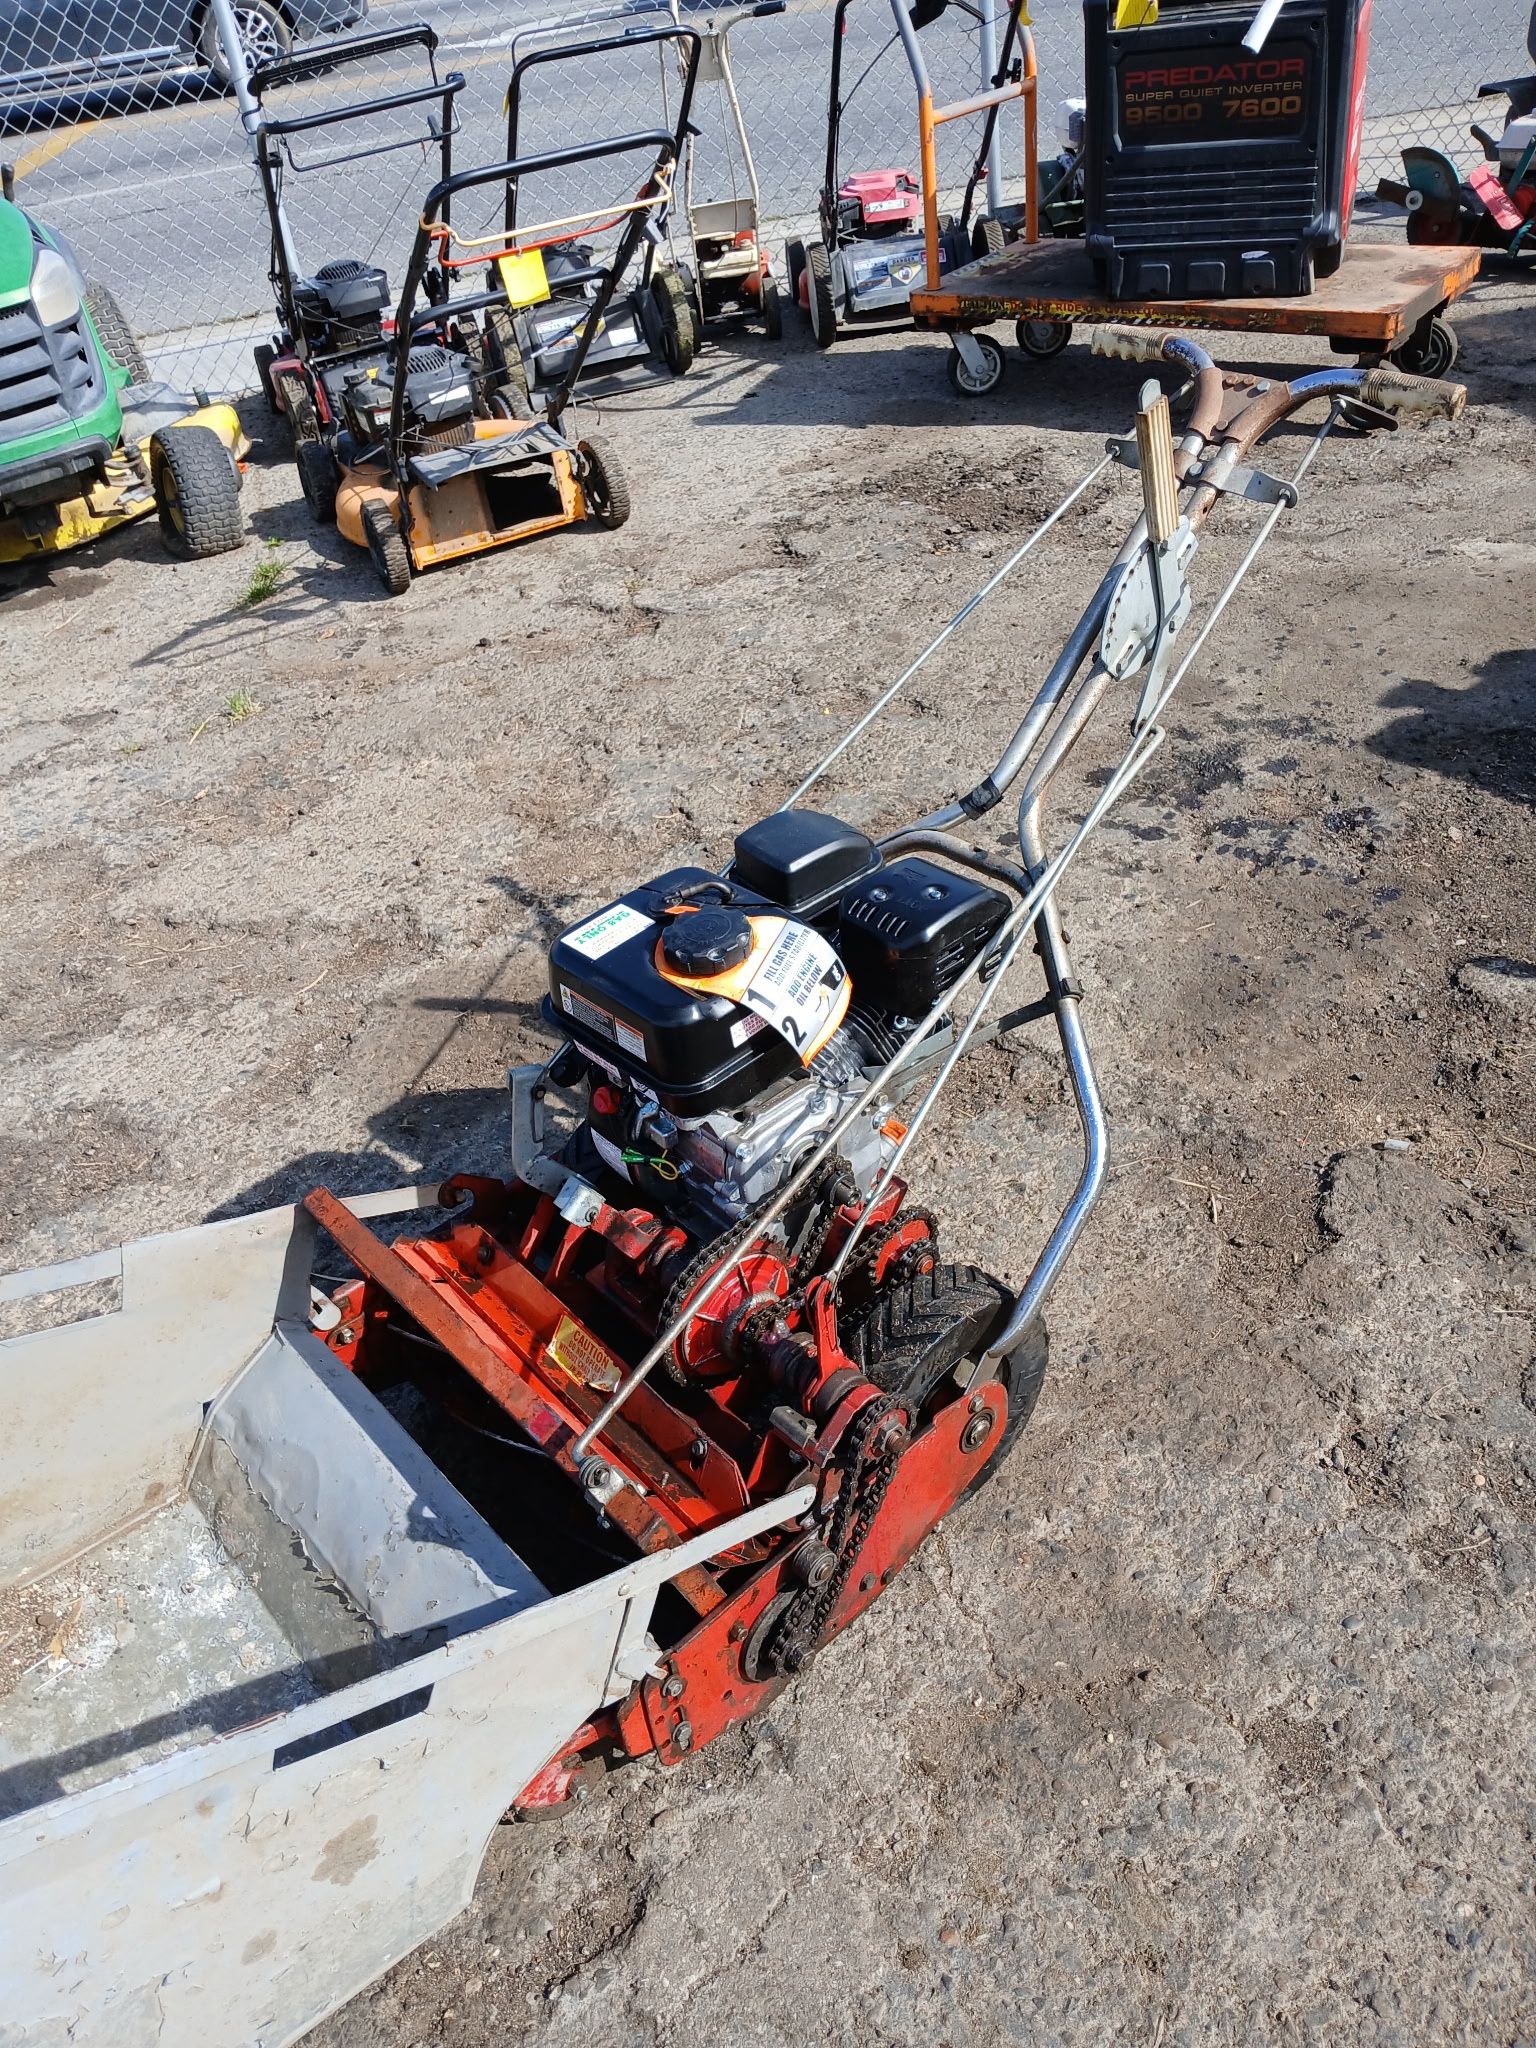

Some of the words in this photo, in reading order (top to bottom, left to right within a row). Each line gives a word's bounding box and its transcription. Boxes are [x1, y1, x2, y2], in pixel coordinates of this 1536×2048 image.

[1125, 58, 1304, 88] PREDATOR
[1126, 91, 1174, 103] SUPER
[1180, 87, 1223, 98] QUIET
[1229, 81, 1303, 95] INVERTER
[1125, 103, 1202, 125] 9500
[1222, 96, 1302, 118] 7600
[1056, 303, 1083, 313] RIDE
[763, 966, 779, 981] FILL
[772, 950, 788, 966] GAS
[781, 931, 798, 951] HERE
[774, 972, 786, 986] ADD
[788, 979, 801, 998] ADD
[797, 953, 818, 981] ENGINE
[796, 992, 808, 1006] OIL
[804, 964, 823, 993] BELOW
[747, 988, 776, 1010] 1
[782, 1016, 807, 1047] 2
[574, 1331, 609, 1369] CAUTION
[586, 1356, 606, 1378] OPERATE
